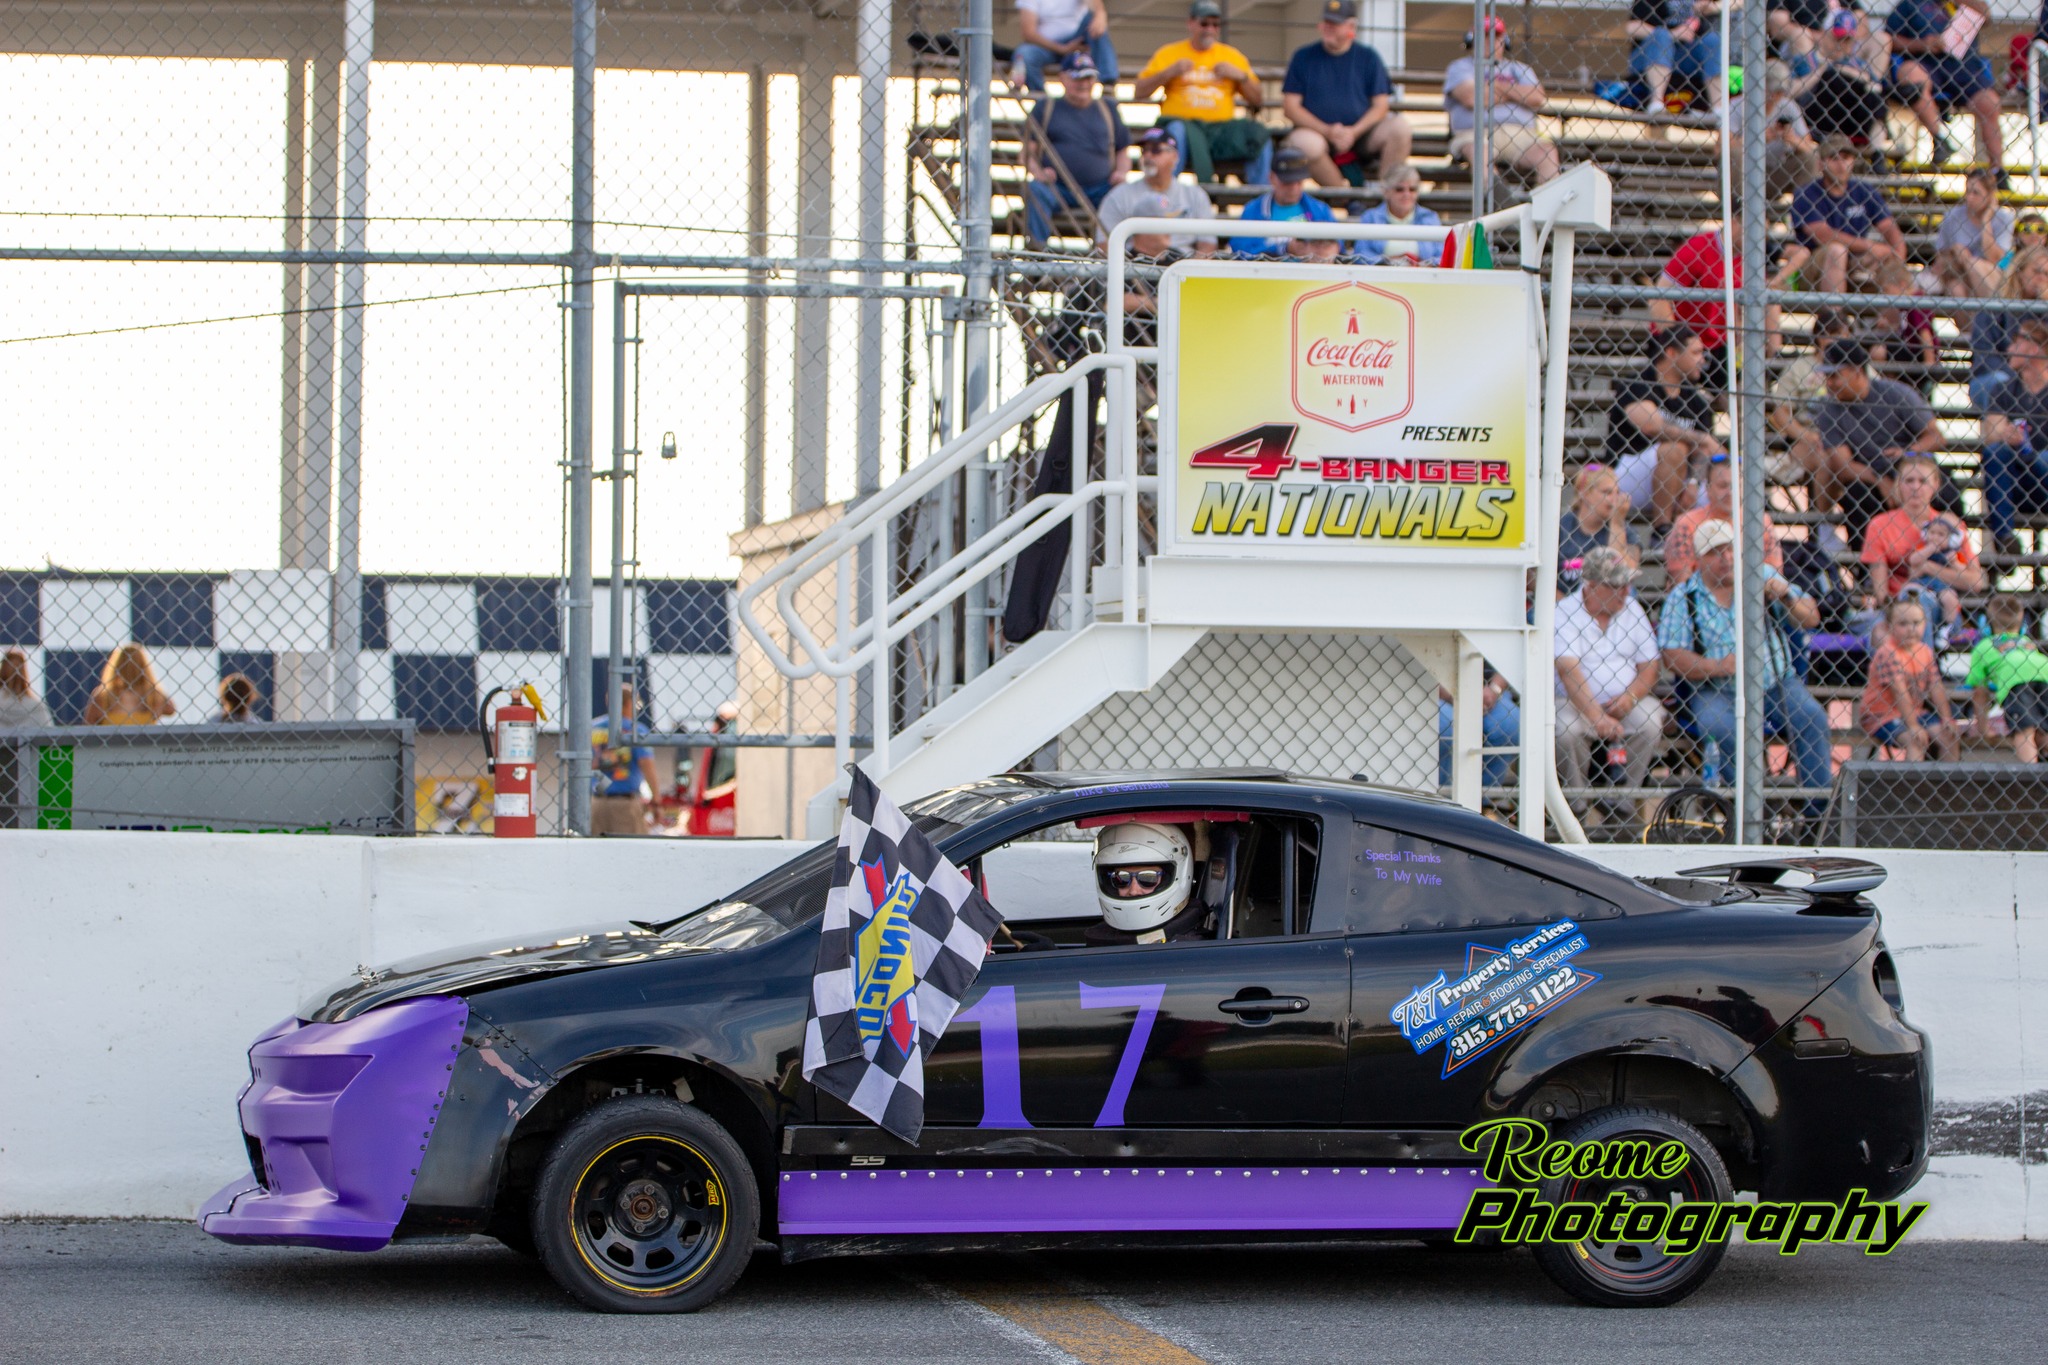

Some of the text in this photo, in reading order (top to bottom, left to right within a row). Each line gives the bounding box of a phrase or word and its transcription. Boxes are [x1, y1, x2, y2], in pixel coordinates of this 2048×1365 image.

[1307, 337, 1399, 369] Coca-Cola
[1322, 374, 1384, 388] WATERTOWN
[1336, 398, 1343, 408] N
[1401, 425, 1494, 443] PRESENTS
[1189, 421, 1511, 485] 4-BANGER
[1191, 481, 1516, 540] NATIONALS
[1365, 849, 1442, 864] Special Thanks
[1375, 867, 1443, 886] To My Wife
[1437, 953, 1514, 1007] Property
[1510, 920, 1575, 960] Services
[1415, 1025, 1448, 1050] HOME
[1532, 937, 1587, 974] SPECIALIST
[1450, 966, 1578, 1058] 315.775.1122
[952, 981, 1167, 1128] 17
[850, 1155, 887, 1166] SS
